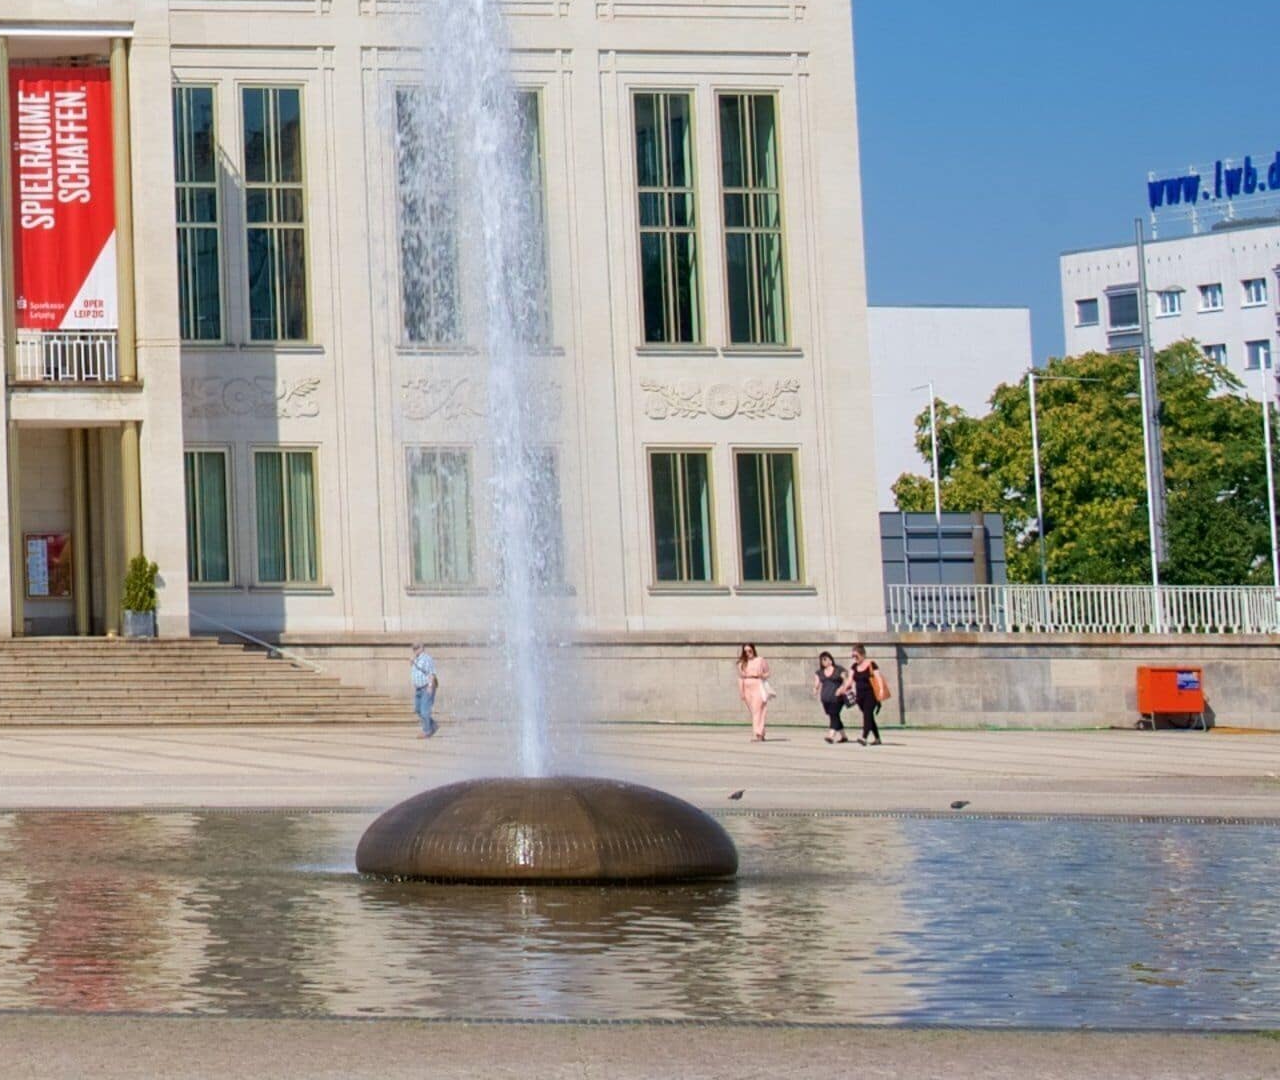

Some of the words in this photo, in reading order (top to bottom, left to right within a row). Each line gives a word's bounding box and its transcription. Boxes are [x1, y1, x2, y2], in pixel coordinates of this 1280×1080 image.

[14, 91, 55, 230] SPIELRÄUME
[54, 86, 91, 204] SCHAFFEN.
[74, 310, 104, 319] LEIPZIG
[83, 299, 104, 308] OPER
